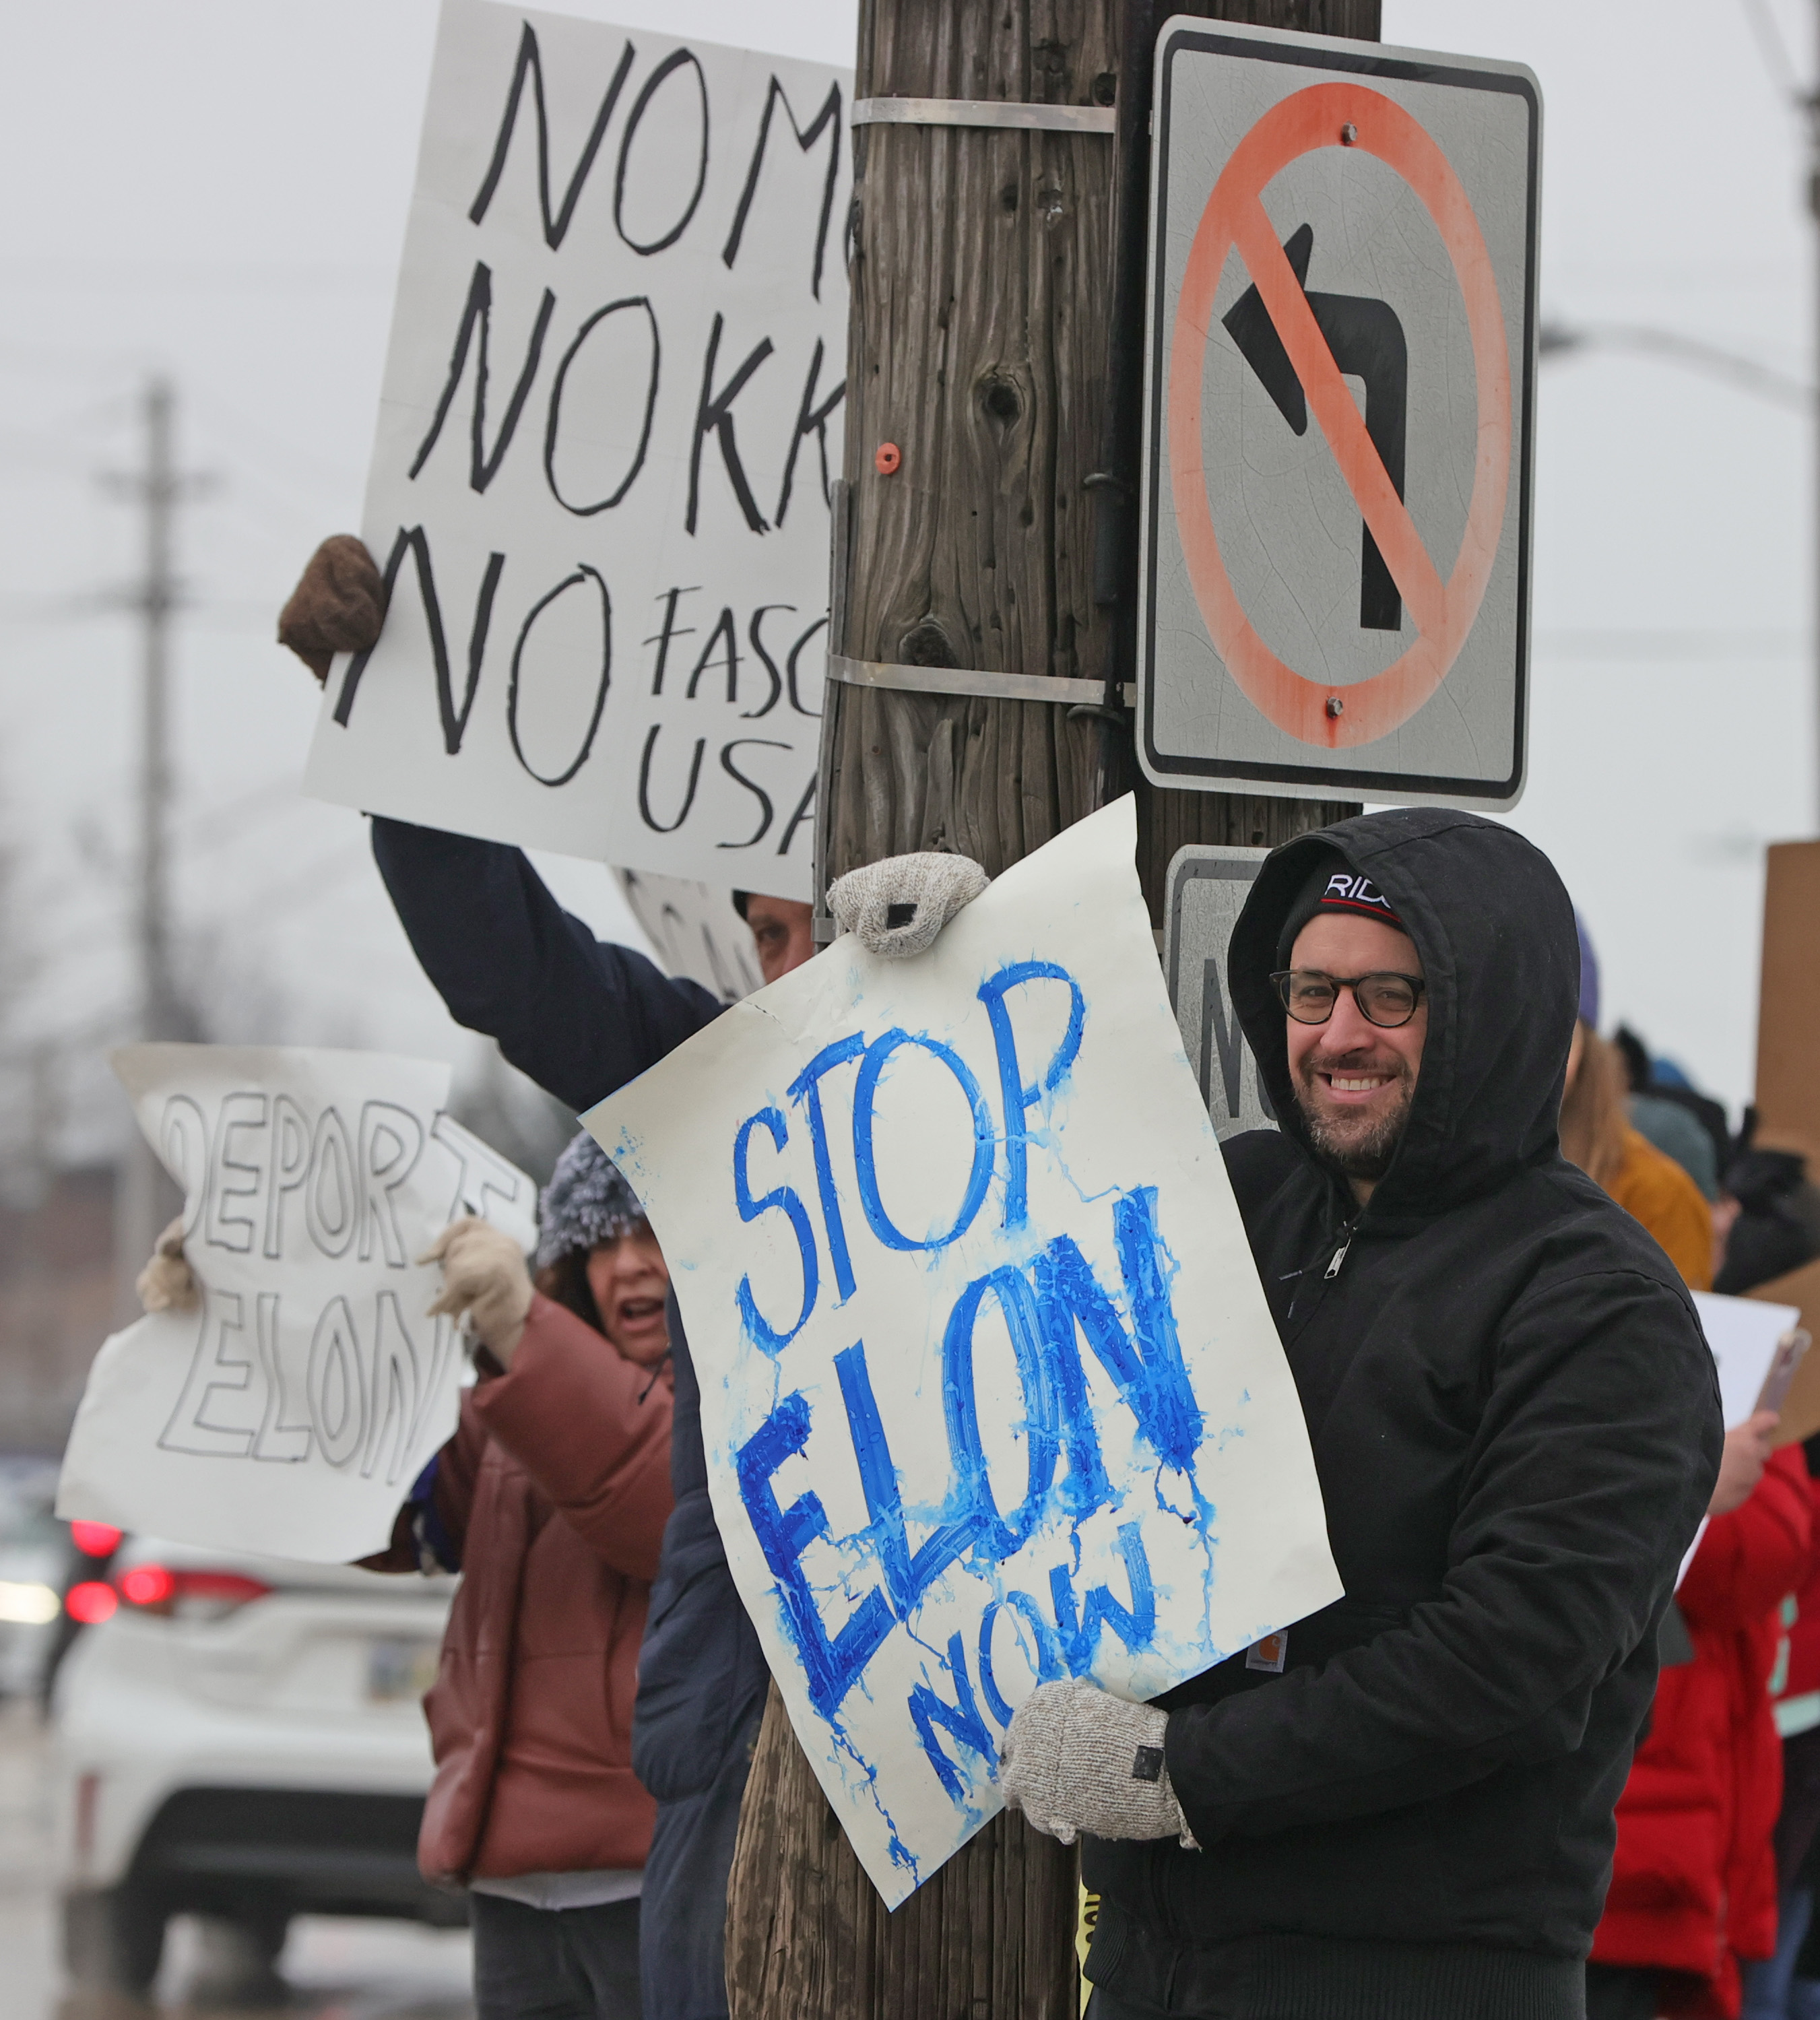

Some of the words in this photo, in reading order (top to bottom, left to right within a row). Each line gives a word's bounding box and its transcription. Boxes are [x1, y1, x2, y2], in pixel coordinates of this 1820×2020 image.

[469, 18, 709, 256] NO
[722, 72, 853, 304] M
[408, 260, 660, 517] NO
[332, 524, 612, 787] NO
[1324, 874, 1392, 909] RID
[734, 960, 1086, 1354] STOP
[1199, 958, 1278, 1121] N
[160, 1092, 521, 1269] DEPORT
[157, 1289, 459, 1487] ELON
[736, 1183, 1204, 1720] ELON
[907, 1521, 1157, 1806] NOW
